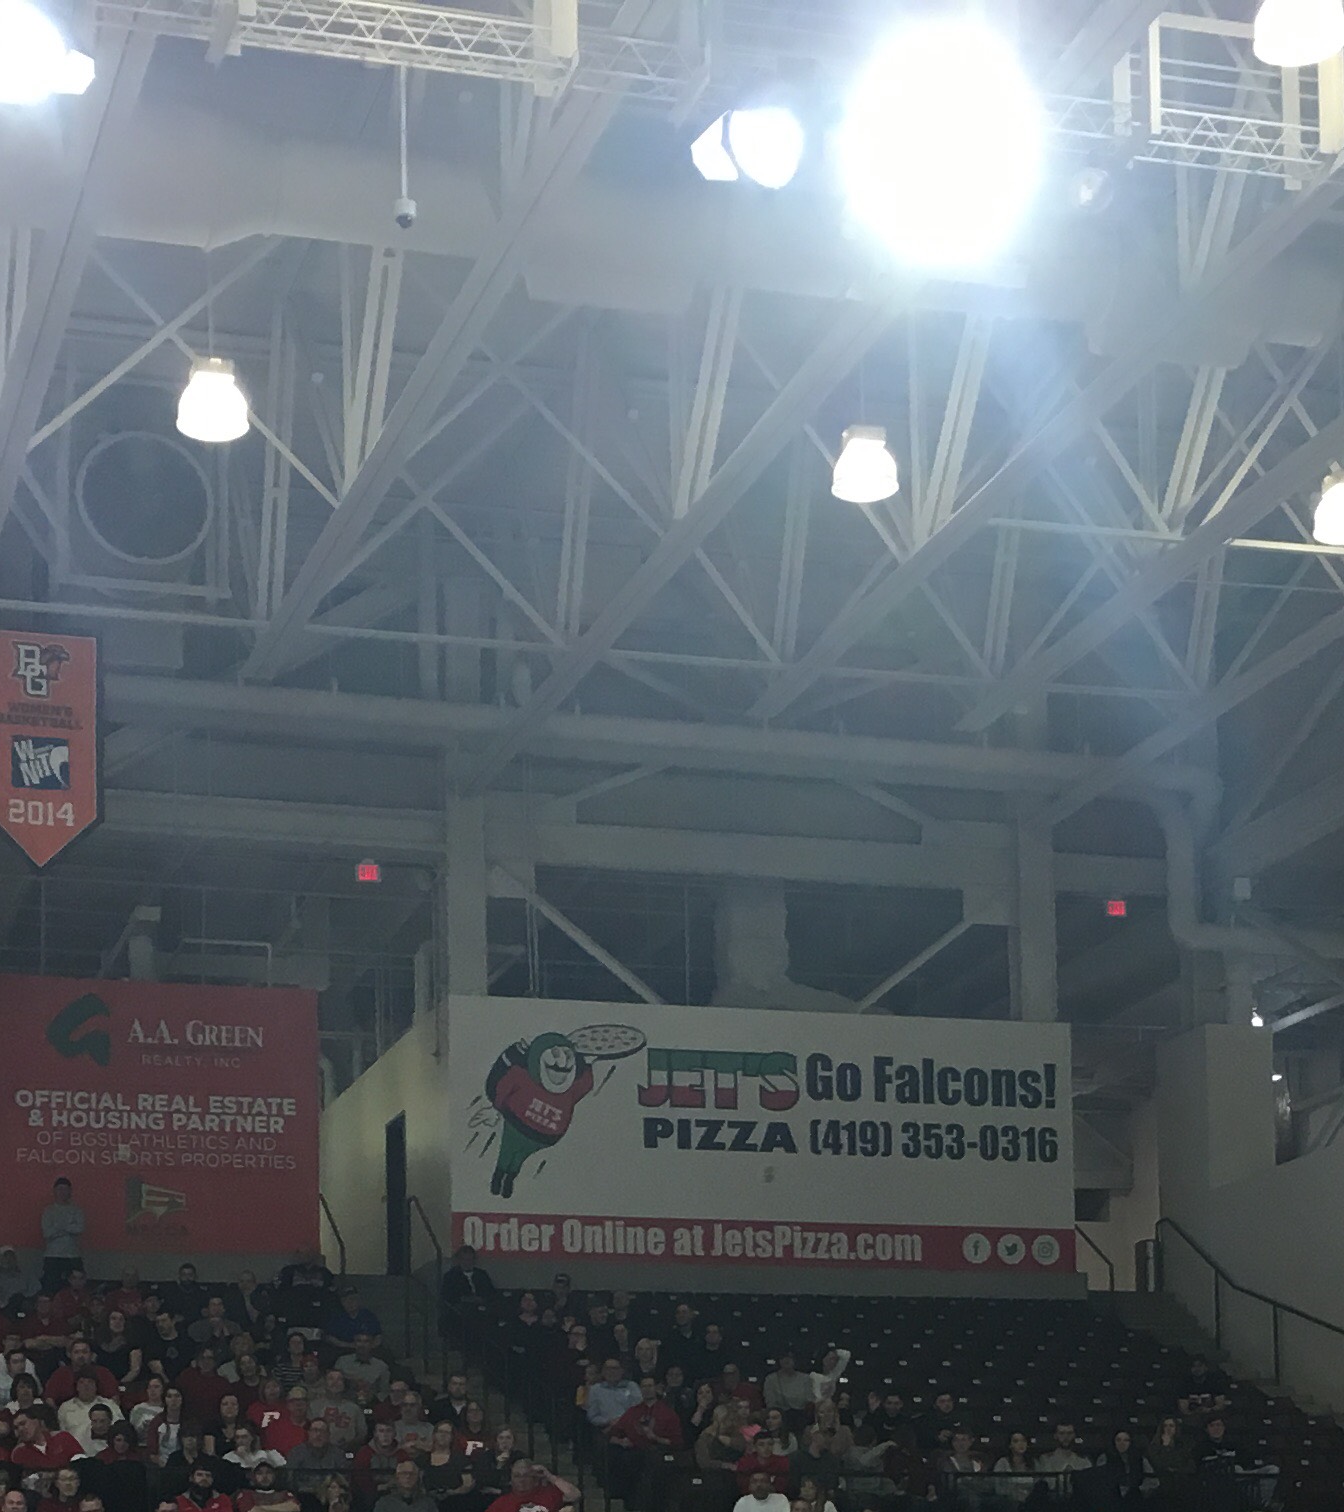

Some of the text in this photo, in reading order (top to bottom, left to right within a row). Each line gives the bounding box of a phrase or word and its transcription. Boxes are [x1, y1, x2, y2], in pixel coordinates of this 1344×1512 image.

[8, 798, 75, 827] 2014
[127, 1018, 179, 1045] A.A.
[637, 1047, 800, 1111] JET'S
[805, 1052, 1057, 1109] Go Falcons!
[14, 1089, 297, 1116] OFFICIAL REAL ESTATE
[28, 1109, 284, 1133] & HOUSING PARTNER
[37, 1131, 277, 1152] OF BGSU ATHLETICS AND
[643, 1117, 1058, 1162] PIZZA (419) 353-0316
[16, 1148, 297, 1170] FALCON SPORTS PROPERTIES
[463, 1215, 923, 1263] Order Online at JetsPizza.com
